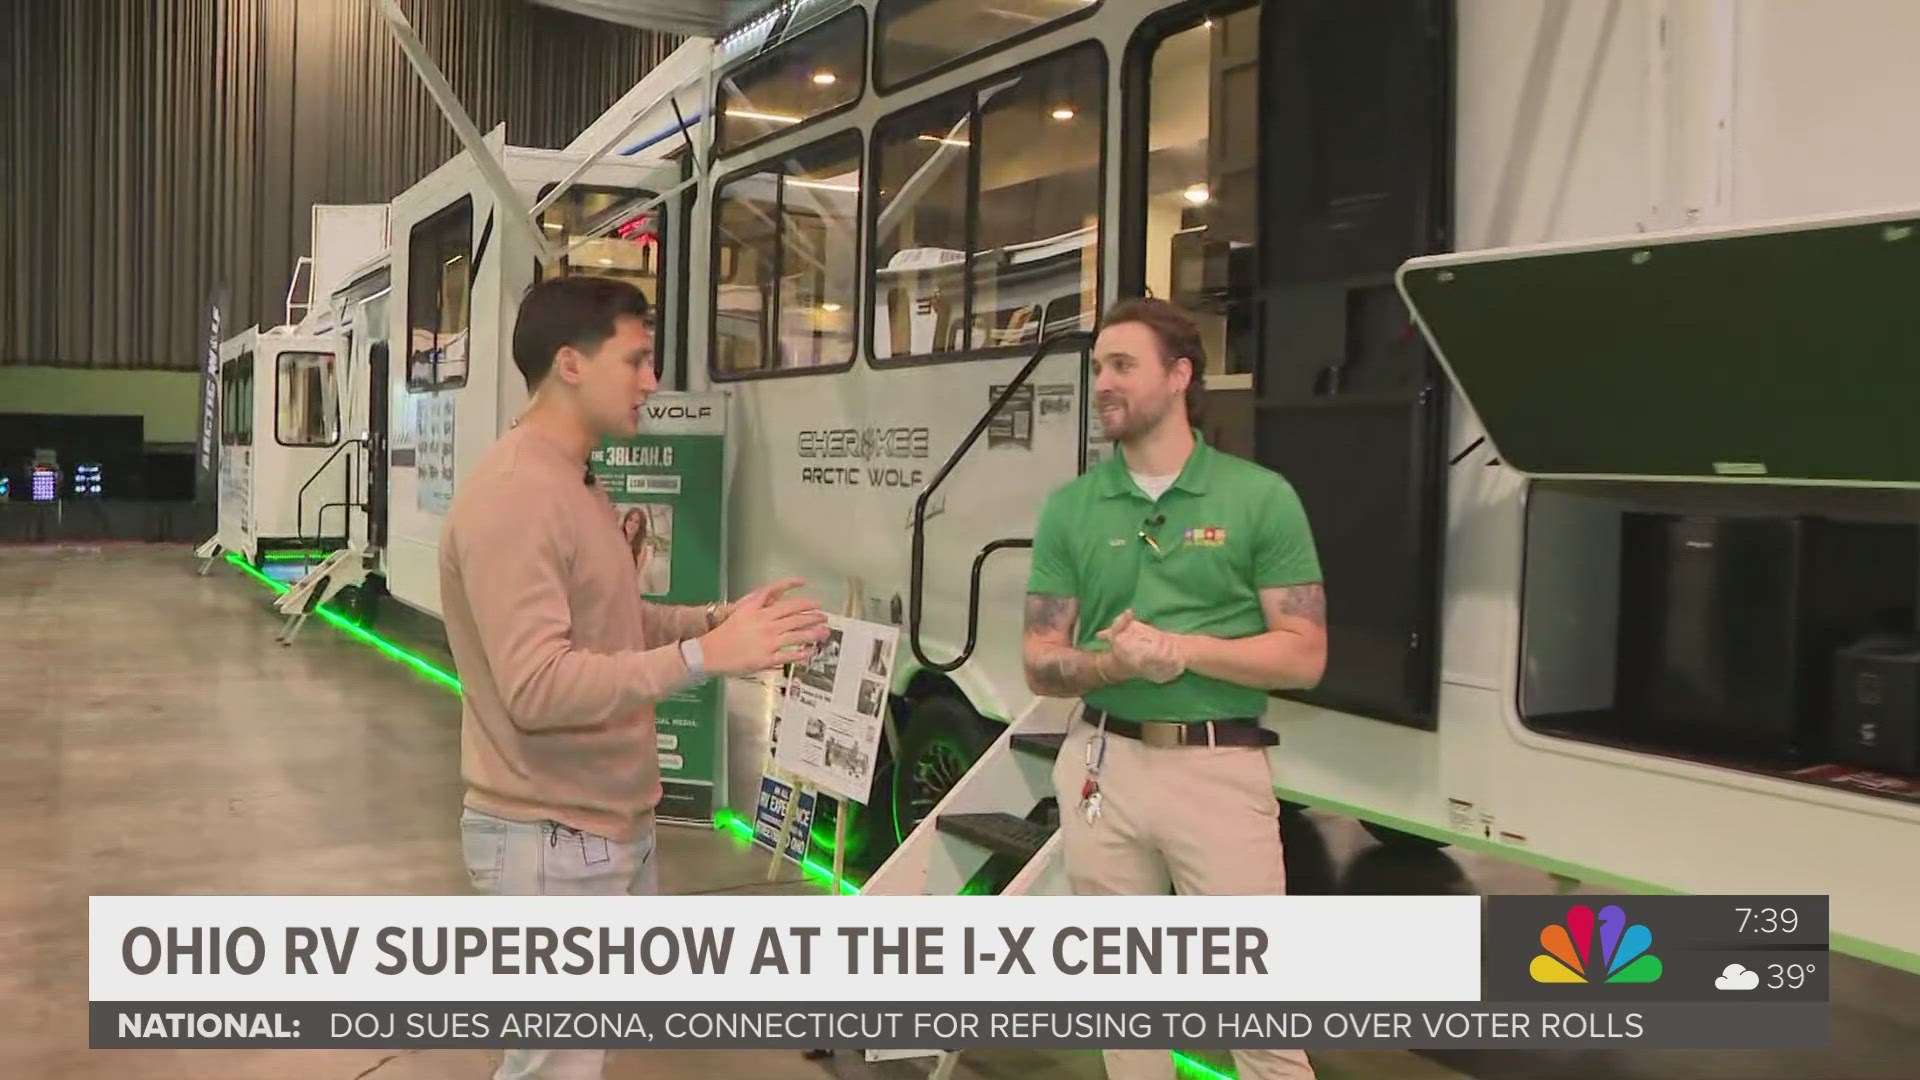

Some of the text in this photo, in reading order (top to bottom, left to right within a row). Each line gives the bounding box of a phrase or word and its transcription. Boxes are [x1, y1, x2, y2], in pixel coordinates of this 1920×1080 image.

[646, 406, 712, 419] WOLF
[802, 467, 922, 488] ARCTIC WOLF
